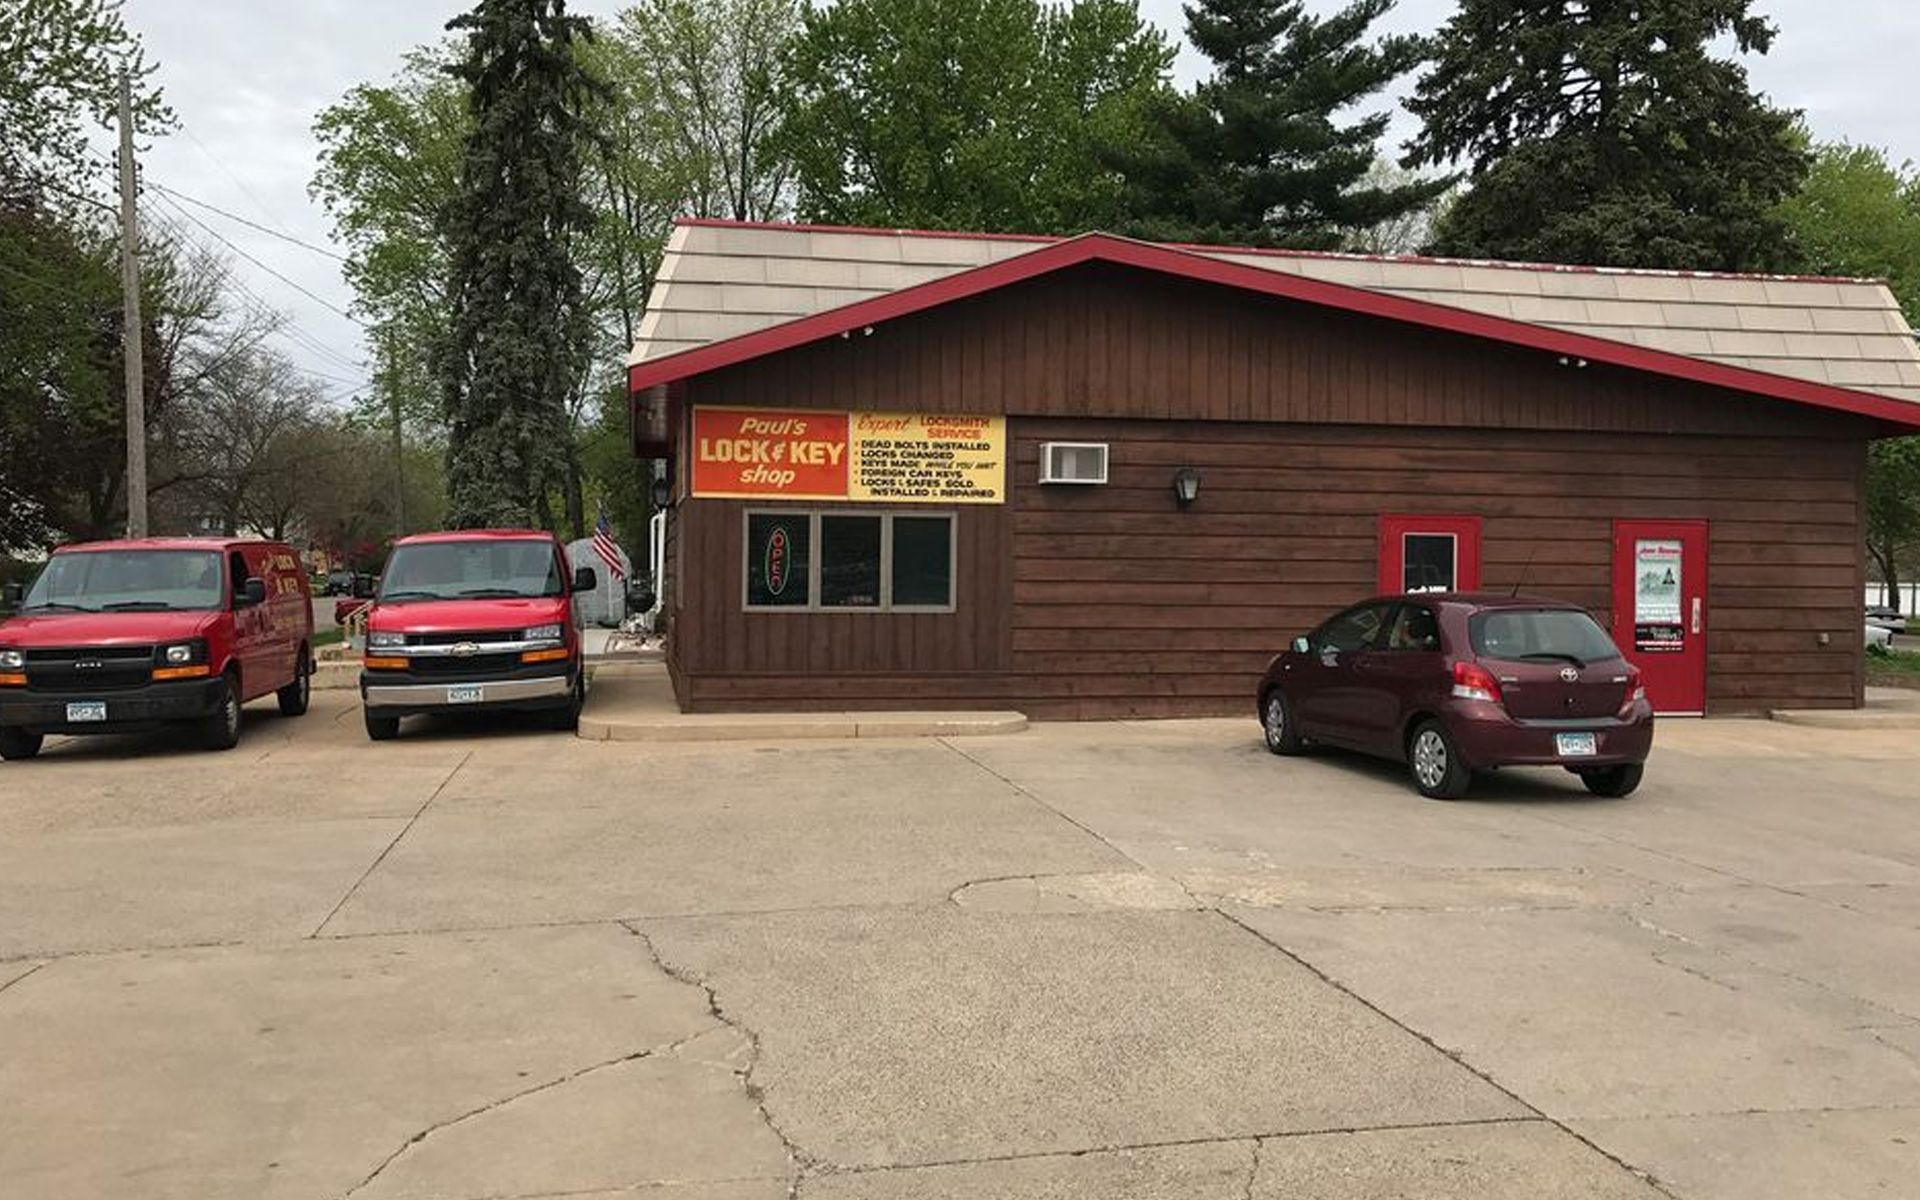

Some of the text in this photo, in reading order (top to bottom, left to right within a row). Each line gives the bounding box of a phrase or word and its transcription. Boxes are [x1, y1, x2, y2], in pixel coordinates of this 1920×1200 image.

[739, 417, 807, 435] Paul's
[858, 413, 912, 434] Expert
[920, 415, 990, 428] LOCKSMITH
[927, 427, 982, 439] SERVICE
[700, 438, 770, 463] LOCK
[789, 441, 845, 464] KEY
[861, 440, 991, 451] DEAD BOLTS INSTALLED
[861, 450, 955, 459] LOCKS CHANGED
[861, 459, 887, 467] KEYS
[890, 460, 921, 468] MADE
[739, 464, 796, 488] shop
[861, 469, 963, 478] FOREIGN CAR KEYS
[861, 478, 897, 487] LOCKS
[906, 479, 941, 488] SAFES
[870, 488, 930, 497] INSTALLED
[940, 489, 996, 498] REPAIRED
[771, 533, 785, 586] OPEN
